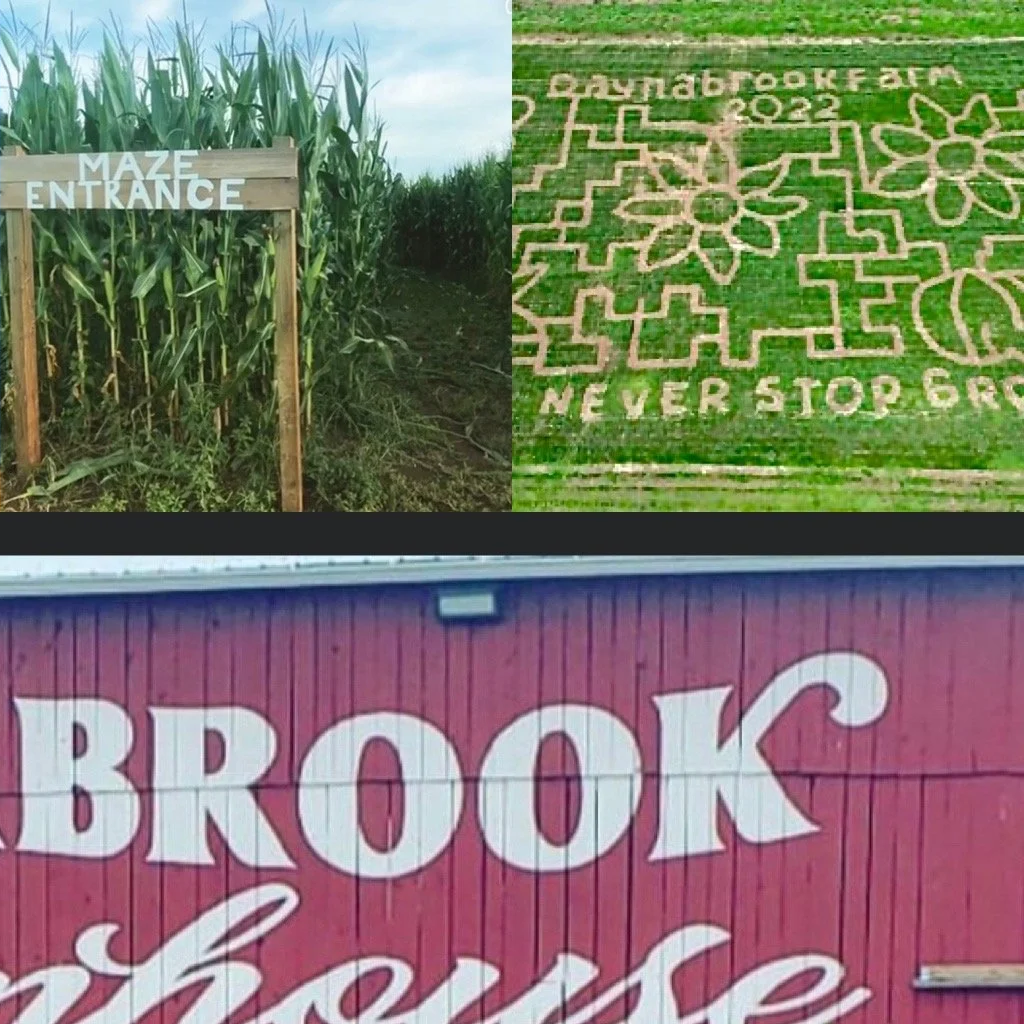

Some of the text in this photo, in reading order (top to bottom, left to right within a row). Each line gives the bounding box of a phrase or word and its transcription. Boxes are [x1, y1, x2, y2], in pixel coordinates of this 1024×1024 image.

[723, 94, 842, 124] 2022
[78, 149, 199, 184] MAZE
[27, 178, 246, 211] ENTRANCE
[540, 376, 731, 422] NEVER
[754, 376, 901, 420] STOP
